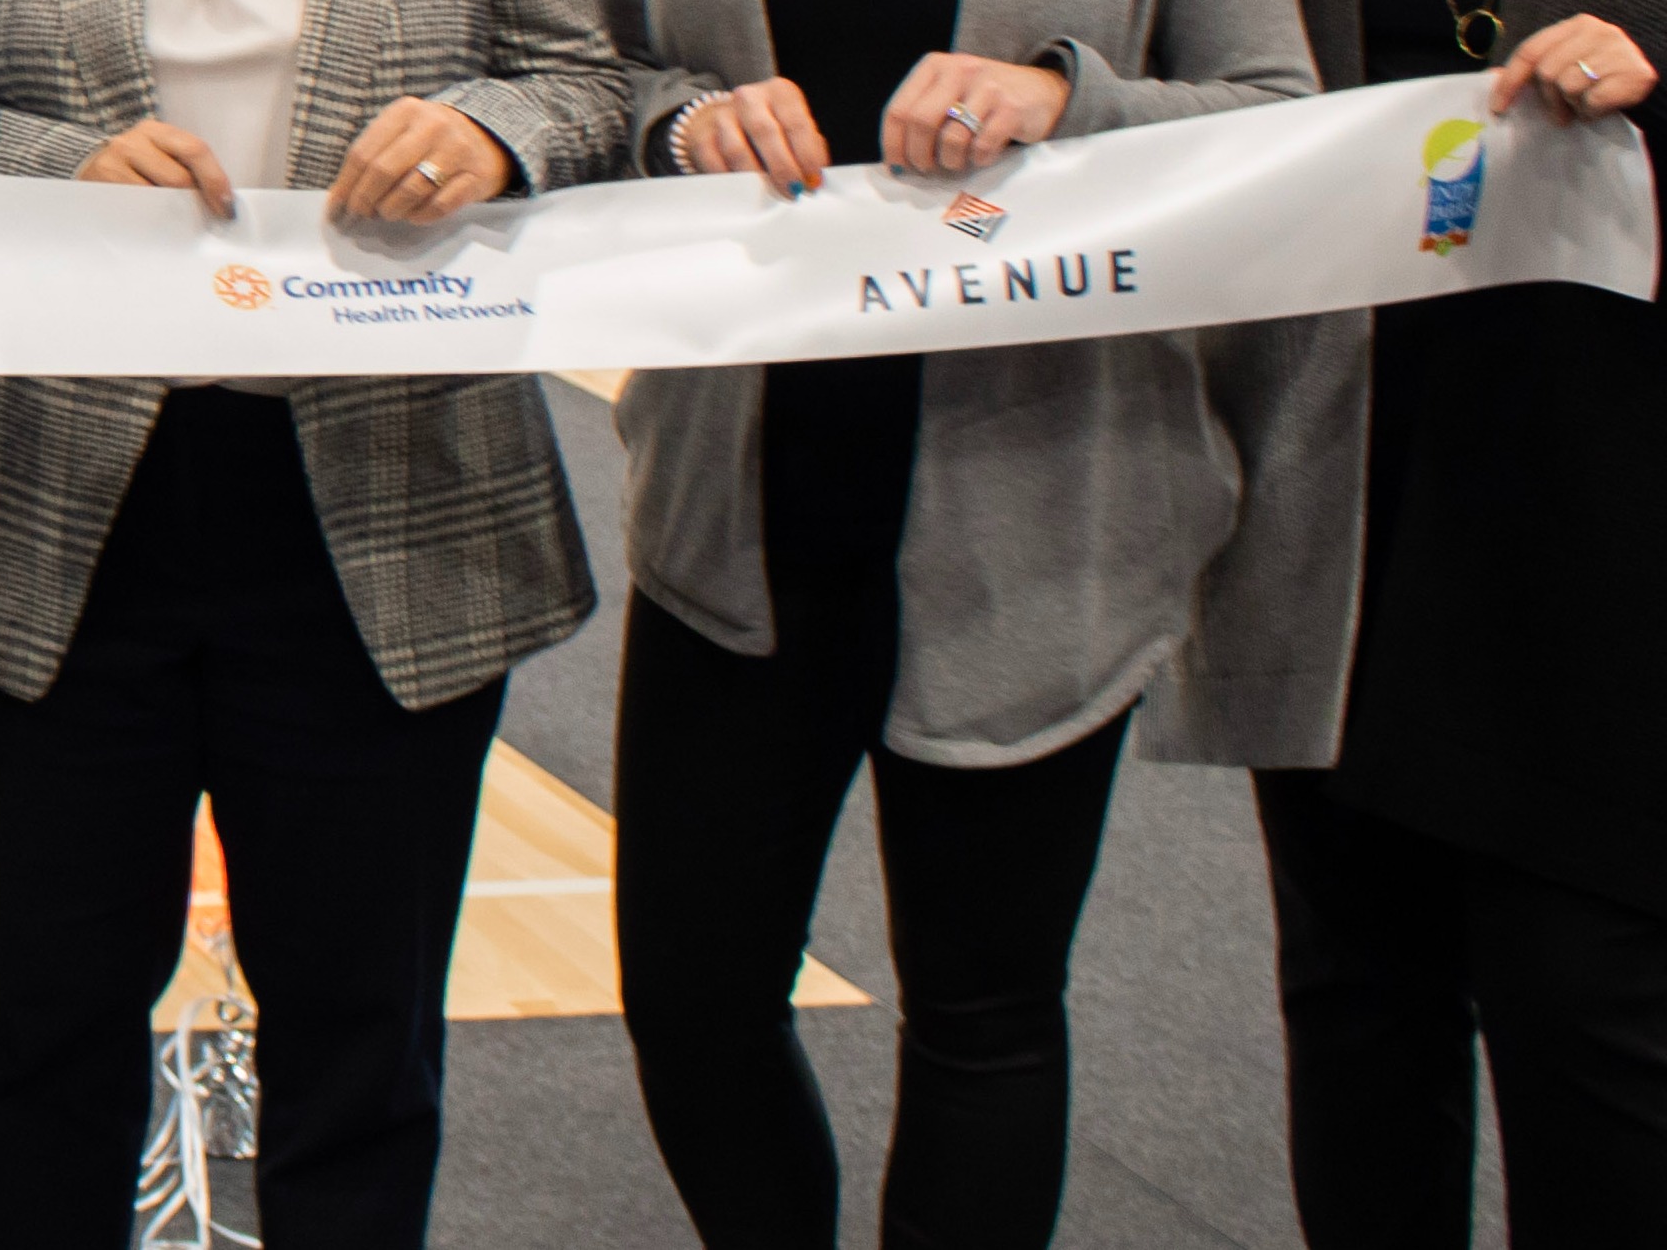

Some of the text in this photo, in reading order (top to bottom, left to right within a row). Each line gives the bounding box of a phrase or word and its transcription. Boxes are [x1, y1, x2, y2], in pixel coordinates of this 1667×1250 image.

[282, 270, 473, 299] Community
[857, 249, 1137, 313] AVENUE
[332, 298, 536, 324] Health Network
